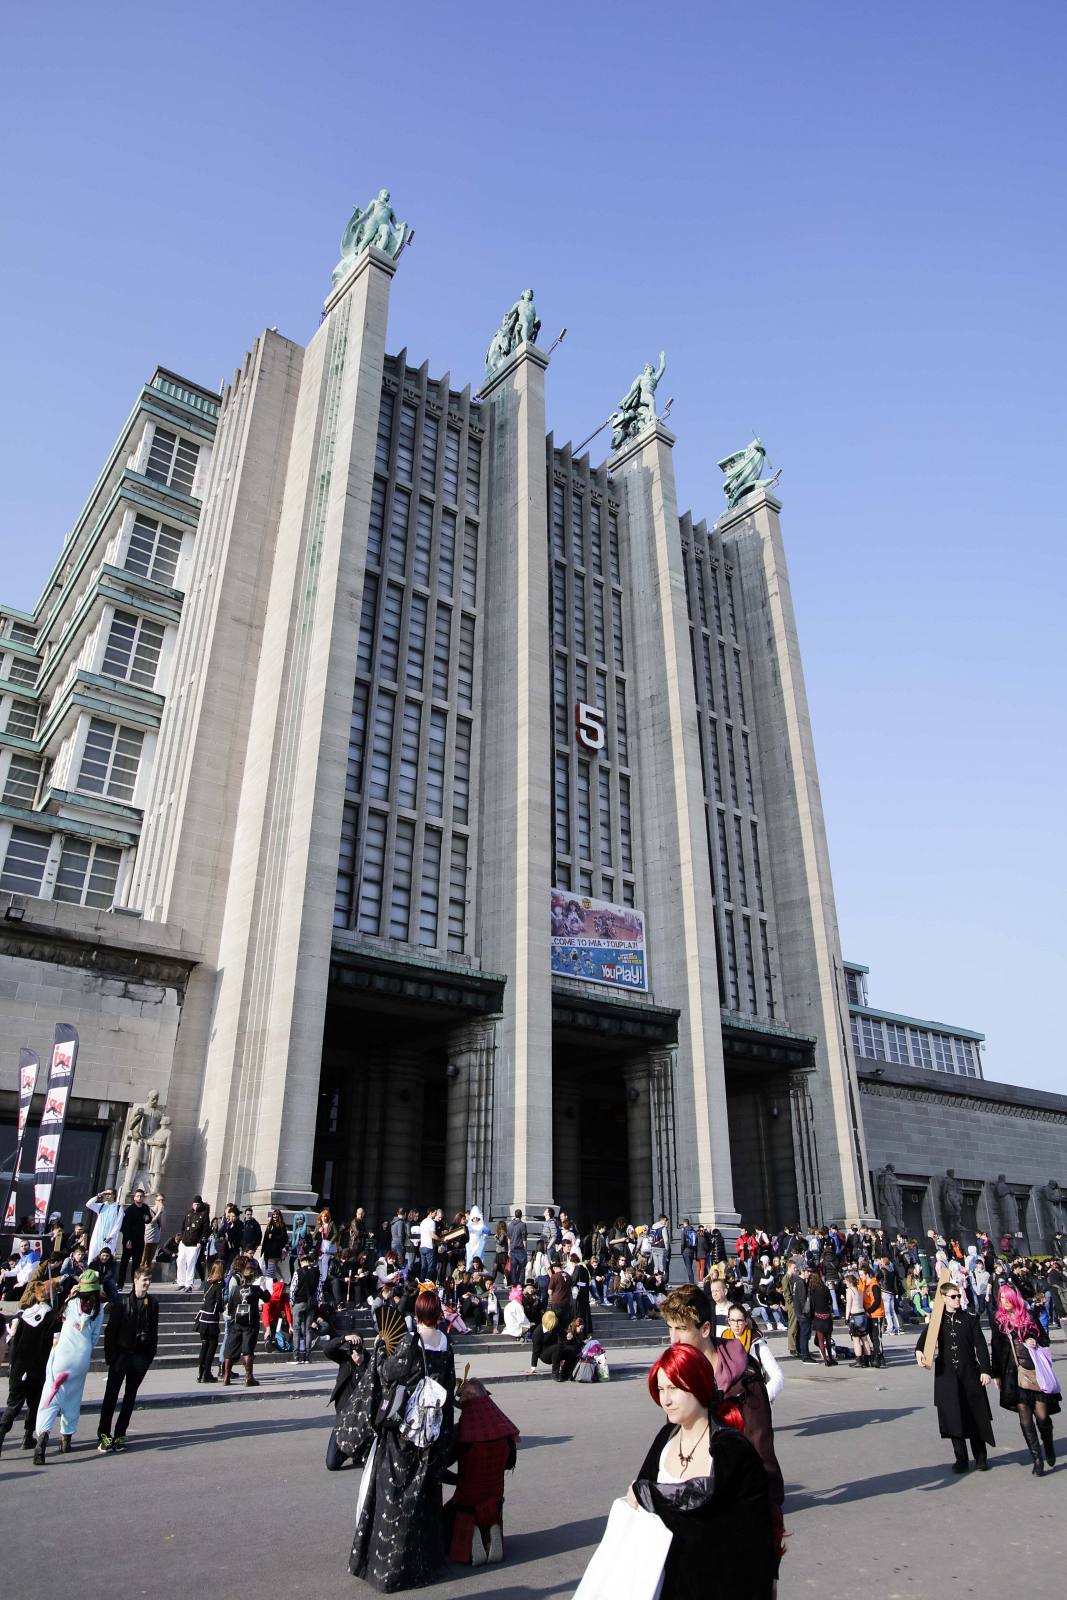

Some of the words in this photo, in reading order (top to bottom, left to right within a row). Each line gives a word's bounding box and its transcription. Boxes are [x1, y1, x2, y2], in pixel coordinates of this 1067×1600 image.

[577, 702, 604, 750] 5
[577, 938, 587, 946] TO
[601, 965, 643, 984] YouPlay!
